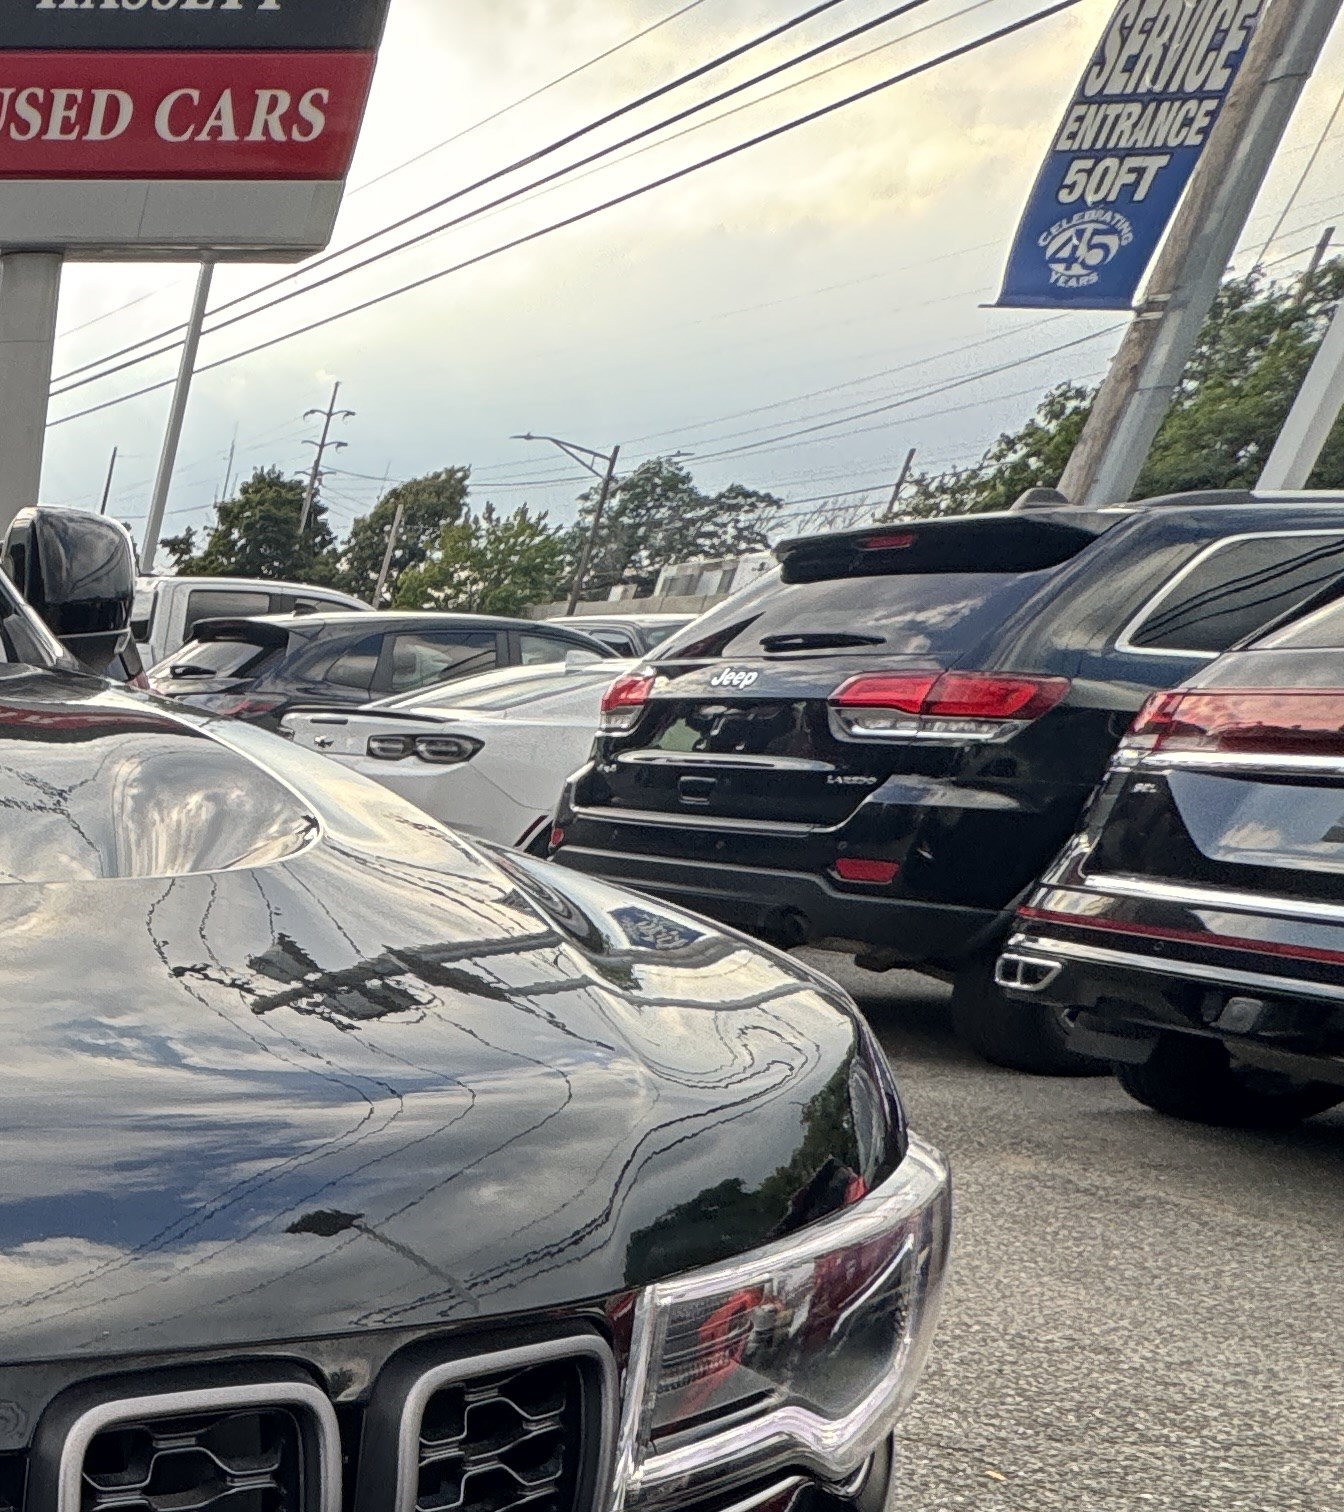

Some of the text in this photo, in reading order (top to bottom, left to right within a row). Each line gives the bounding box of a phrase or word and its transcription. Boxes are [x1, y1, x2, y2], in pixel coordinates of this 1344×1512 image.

[1084, 0, 1262, 97] SERVICE
[154, 87, 330, 142] CARS
[1055, 99, 1218, 151] ENTRANCE
[1058, 154, 1170, 204] 50FT
[1037, 208, 1134, 247] CELEBRATING
[1049, 271, 1099, 288] YEARS
[711, 667, 758, 690] Jeep
